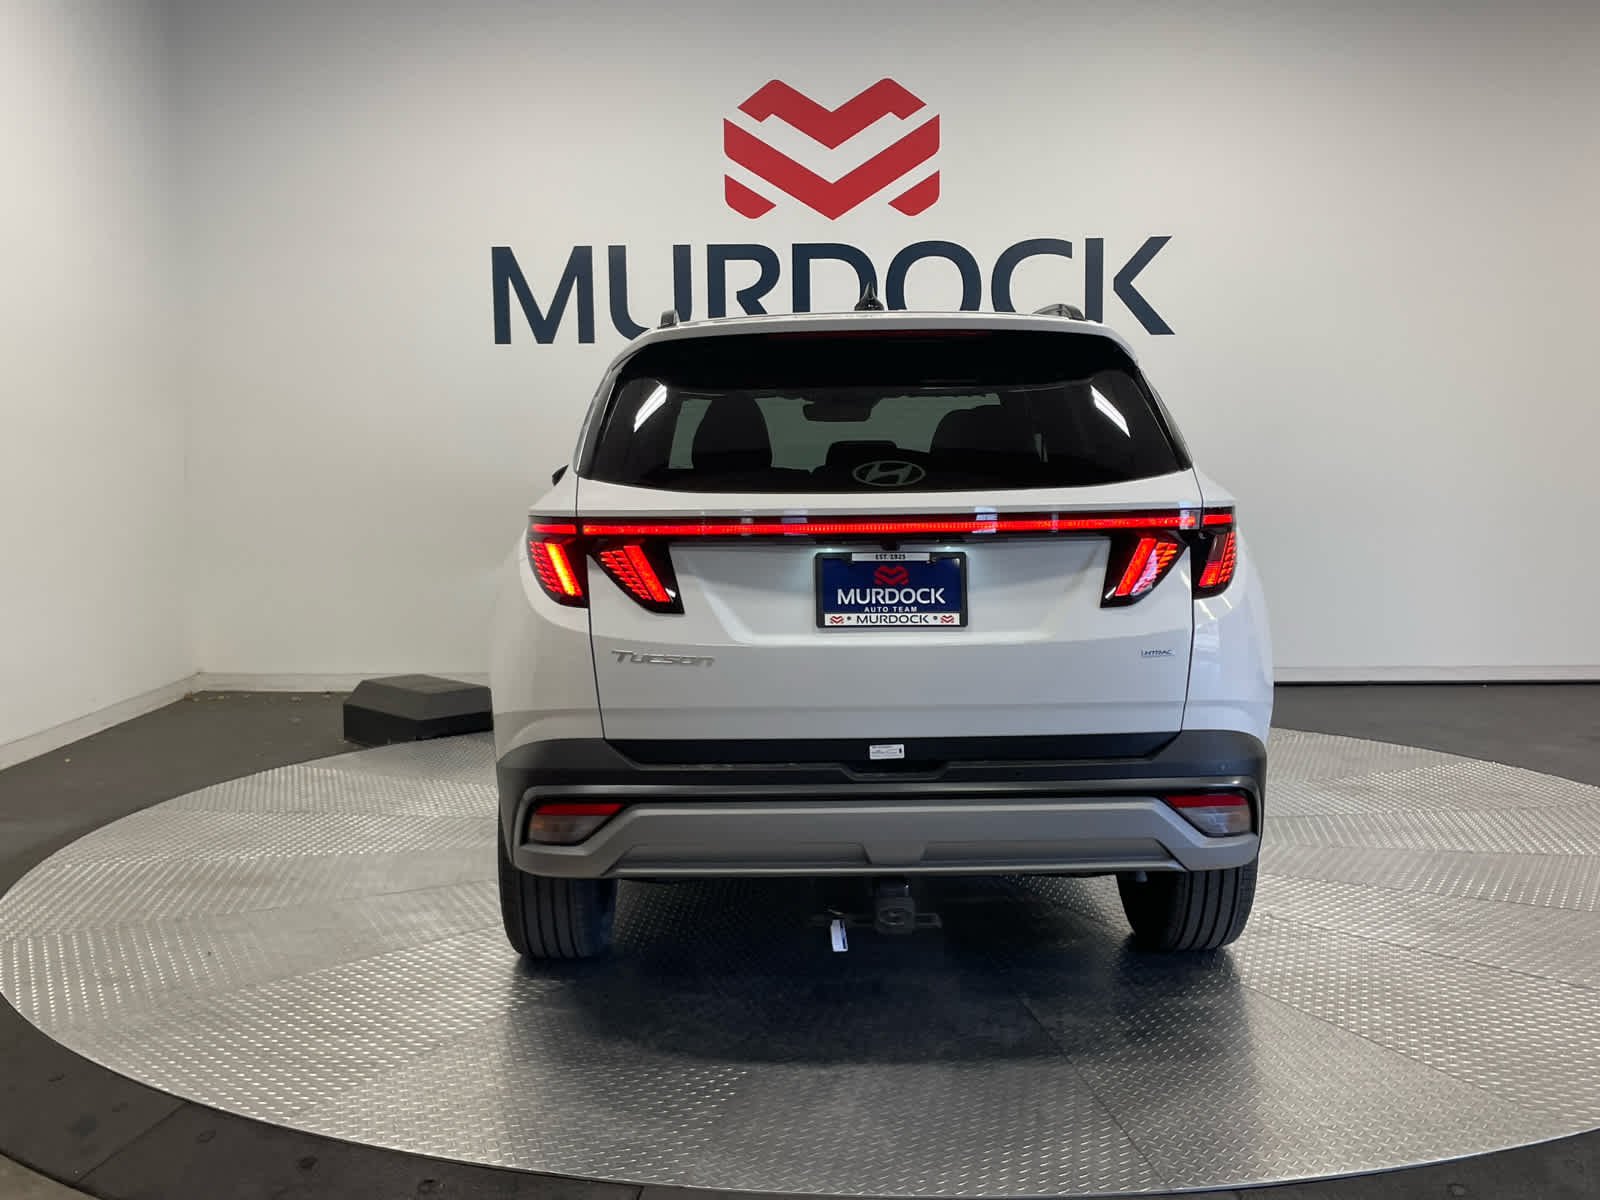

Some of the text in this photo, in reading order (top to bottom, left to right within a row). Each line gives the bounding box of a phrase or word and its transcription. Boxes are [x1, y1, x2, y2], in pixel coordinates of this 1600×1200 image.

[491, 236, 1175, 345] MURDOCK
[837, 588, 946, 605] MURDOCK
[856, 614, 930, 624] MURDOCK
